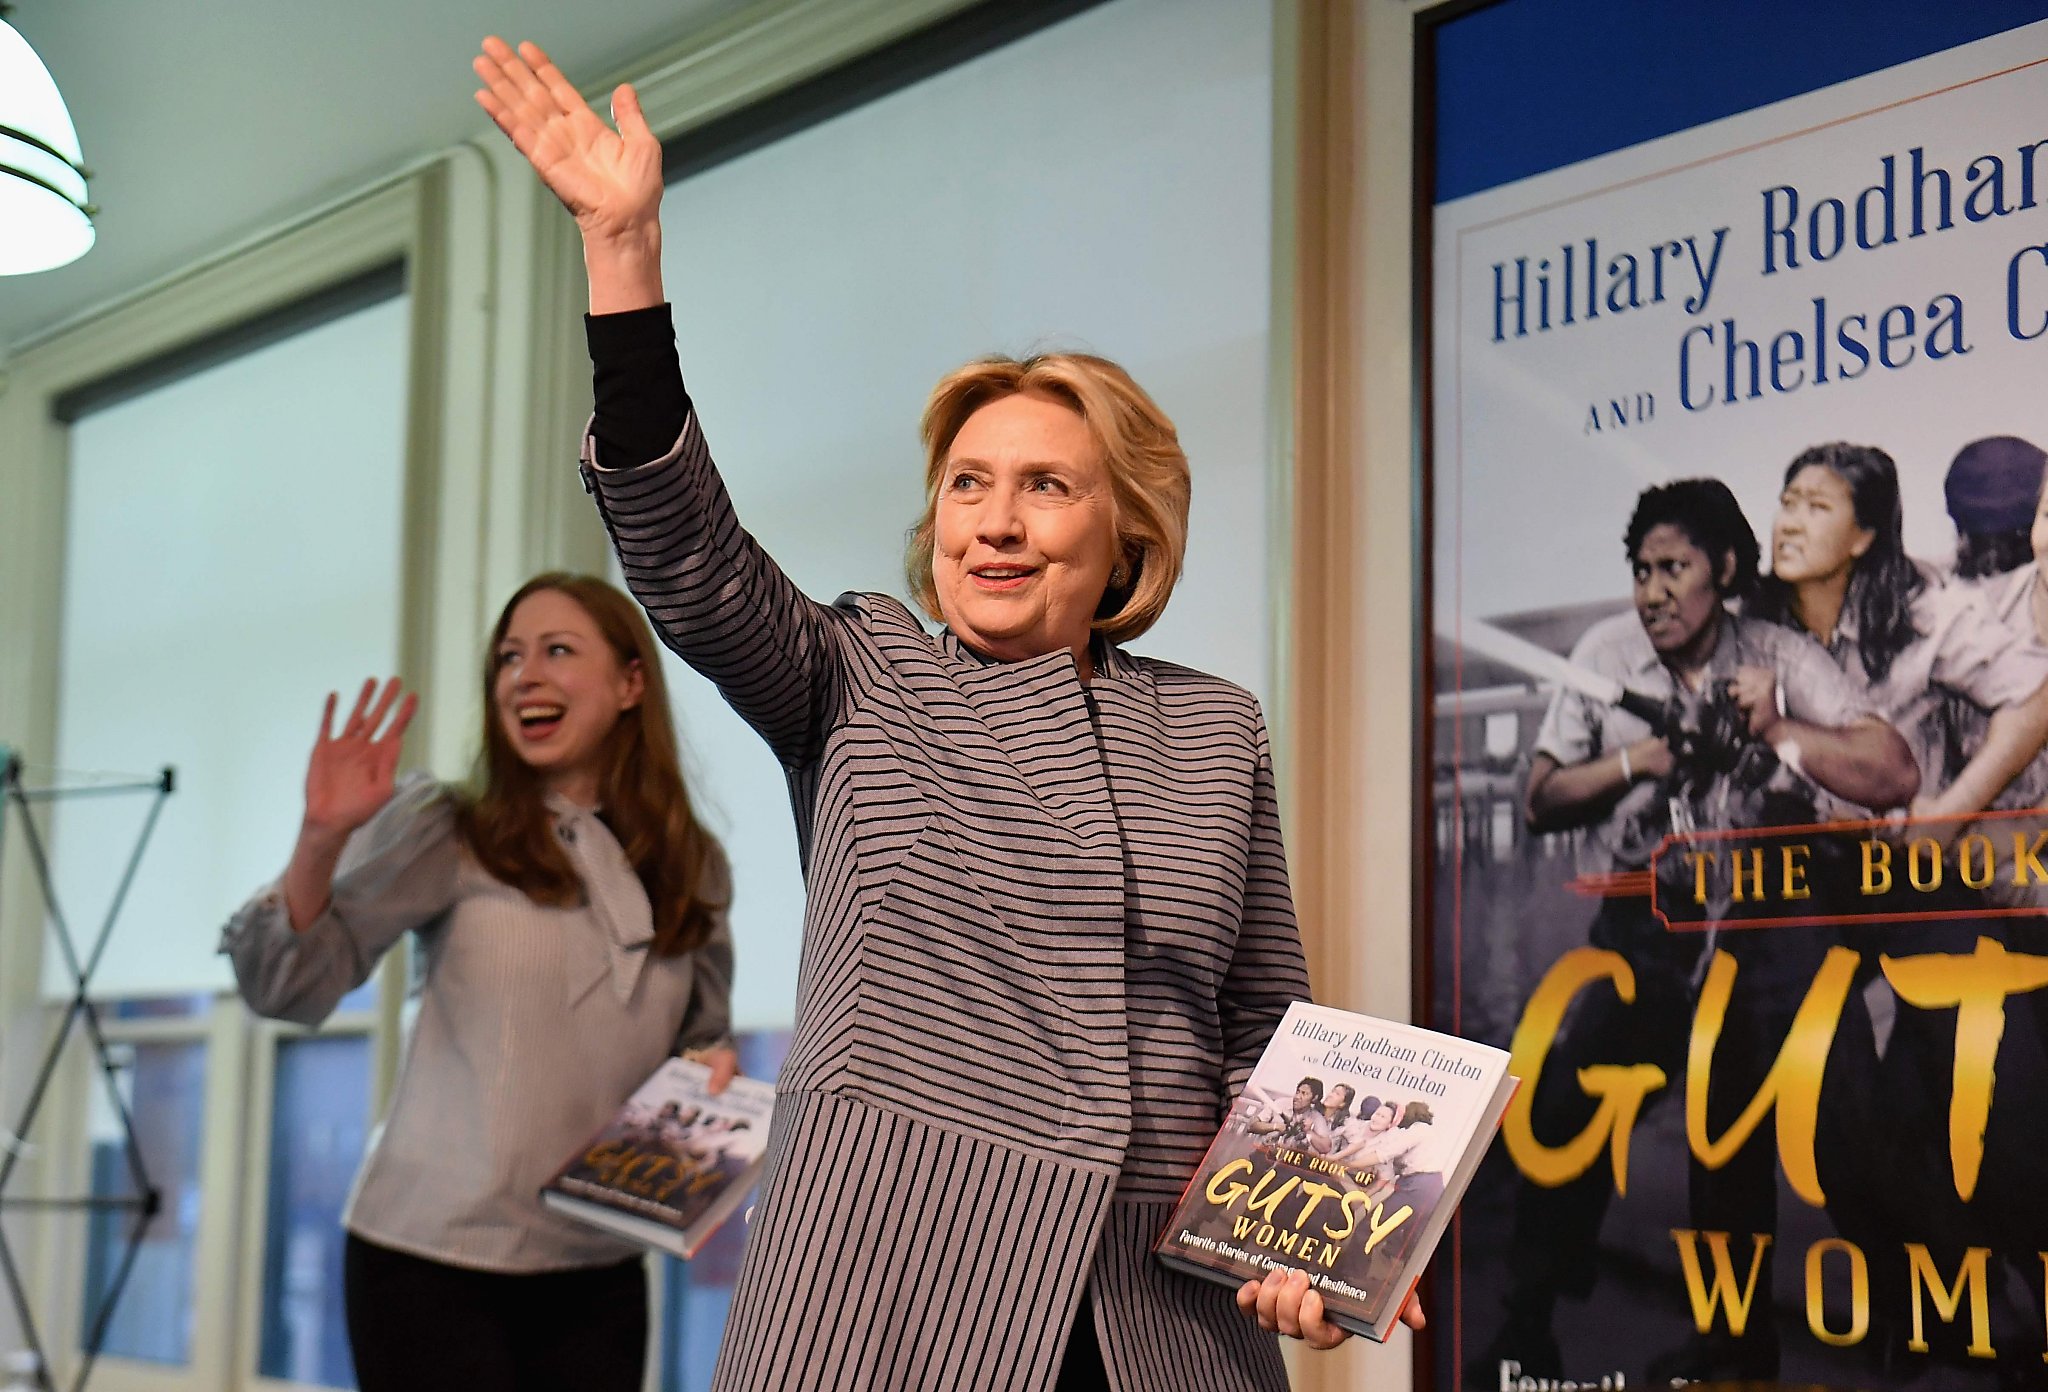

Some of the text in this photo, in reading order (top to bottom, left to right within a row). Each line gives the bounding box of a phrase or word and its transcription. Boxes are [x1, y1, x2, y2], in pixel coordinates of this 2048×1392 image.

[1490, 227, 1731, 344] Hillary
[1583, 391, 1655, 436] AND
[1679, 293, 1975, 413] Chelsea
[1684, 830, 2048, 905] THE BOOK
[1291, 1018, 1482, 1081] Hillary Rodham Clinton
[1302, 1049, 1447, 1097] AND Chelsea Clinton
[1275, 1147, 1375, 1186] THE BOOK OF
[1205, 1158, 1413, 1255] GUTSY
[1233, 1214, 1342, 1269] WOMEN
[1179, 1229, 1216, 1251] Favorite
[1216, 1240, 1248, 1264] Stories
[1249, 1253, 1264, 1268] of
[1307, 1272, 1320, 1287] nd
[1319, 1274, 1367, 1302] Resilience
[1670, 1228, 2048, 1364] WOM
